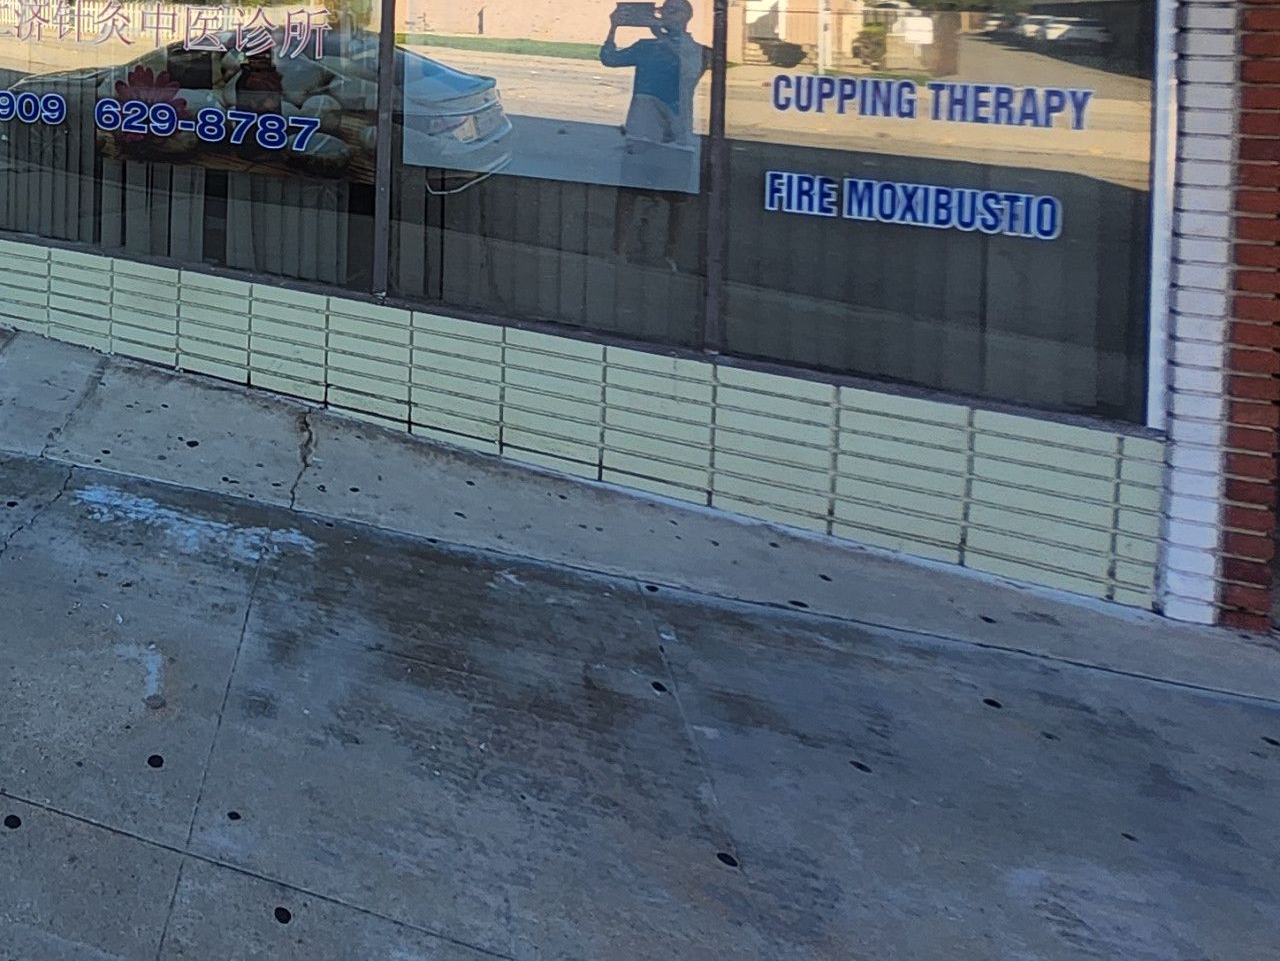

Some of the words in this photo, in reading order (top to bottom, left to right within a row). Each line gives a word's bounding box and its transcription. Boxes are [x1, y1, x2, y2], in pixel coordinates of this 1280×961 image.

[94, 98, 321, 151] 629-8787
[773, 74, 917, 118] CUPPING
[926, 82, 1094, 131] THERAPY
[765, 171, 838, 217] FIRE
[843, 178, 1062, 240] MOXIBUSTIO
